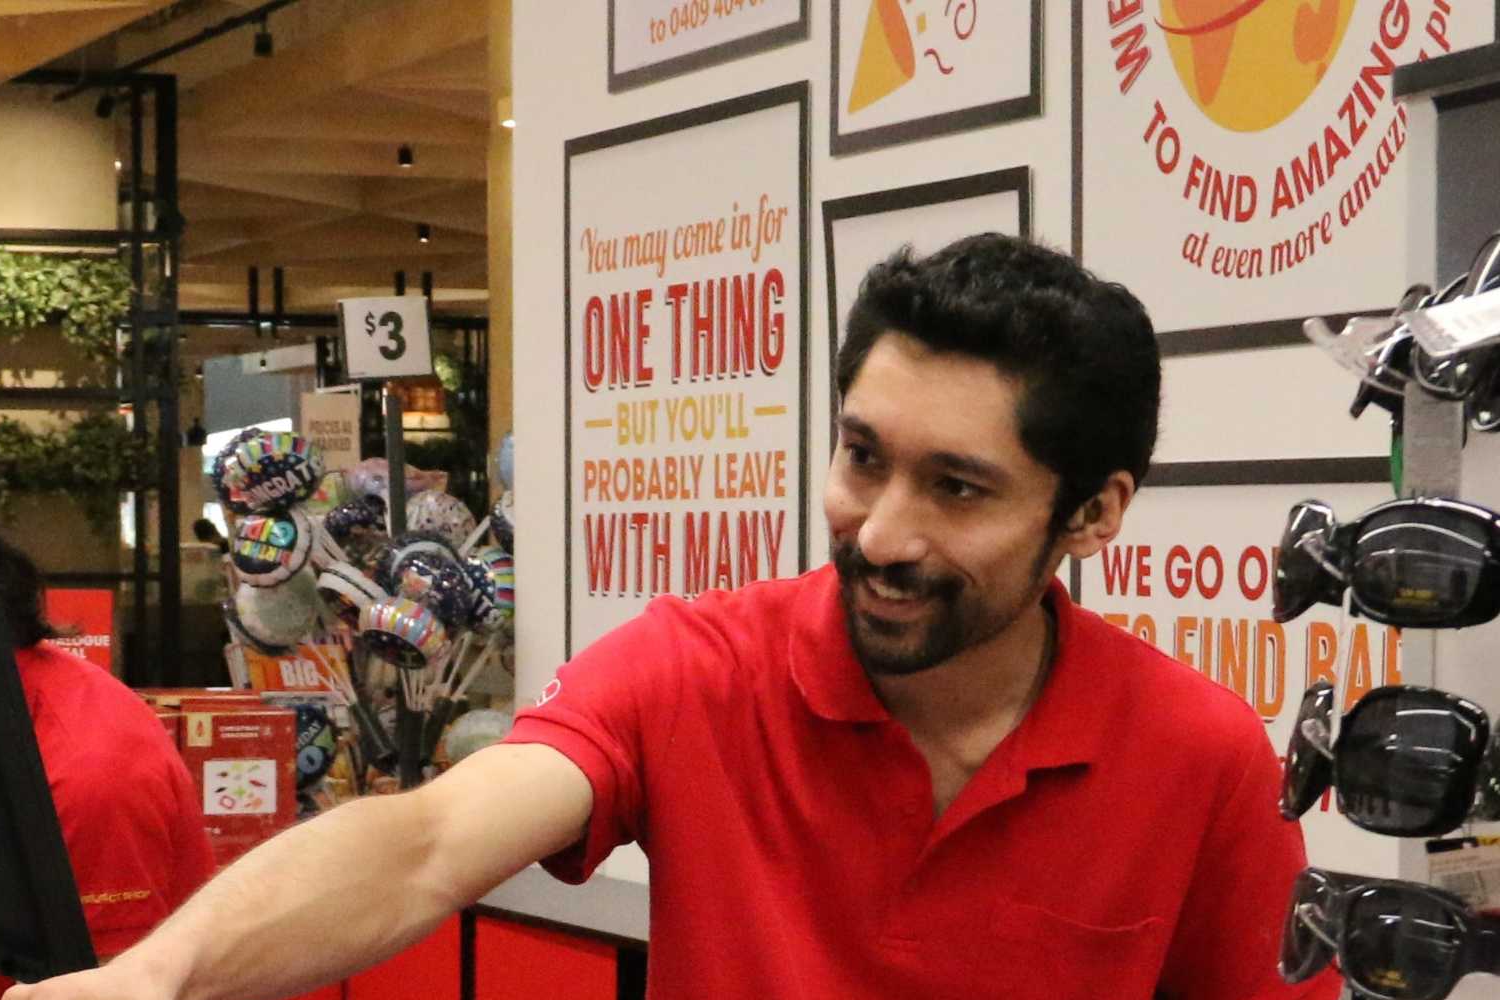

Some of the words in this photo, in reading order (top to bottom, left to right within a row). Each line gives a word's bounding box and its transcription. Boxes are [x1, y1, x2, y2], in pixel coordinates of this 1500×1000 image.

[649, 16, 666, 44] to
[1142, 99, 1181, 175] TO
[1182, 154, 1258, 224] FIND
[1270, 0, 1411, 219] AMAZING
[1181, 231, 1211, 268] at
[1211, 245, 1263, 280] even
[1269, 210, 1333, 277] more
[1338, 104, 1407, 227] amaz
[580, 226, 618, 275] You
[621, 228, 668, 278] may
[672, 216, 725, 261] come
[730, 201, 752, 251] in
[751, 193, 788, 263] for
[365, 311, 407, 362] $3
[583, 288, 654, 393] ONE
[665, 267, 785, 384] THING
[616, 399, 659, 446] BUT
[664, 392, 750, 443] YOU'LL
[583, 454, 704, 502] PROBABLY
[714, 450, 787, 500] LEAVE
[583, 511, 671, 598] WITH
[683, 509, 786, 600] MANY
[1101, 544, 1152, 597] WE
[1164, 544, 1224, 600] GO
[1237, 545, 1278, 601] O
